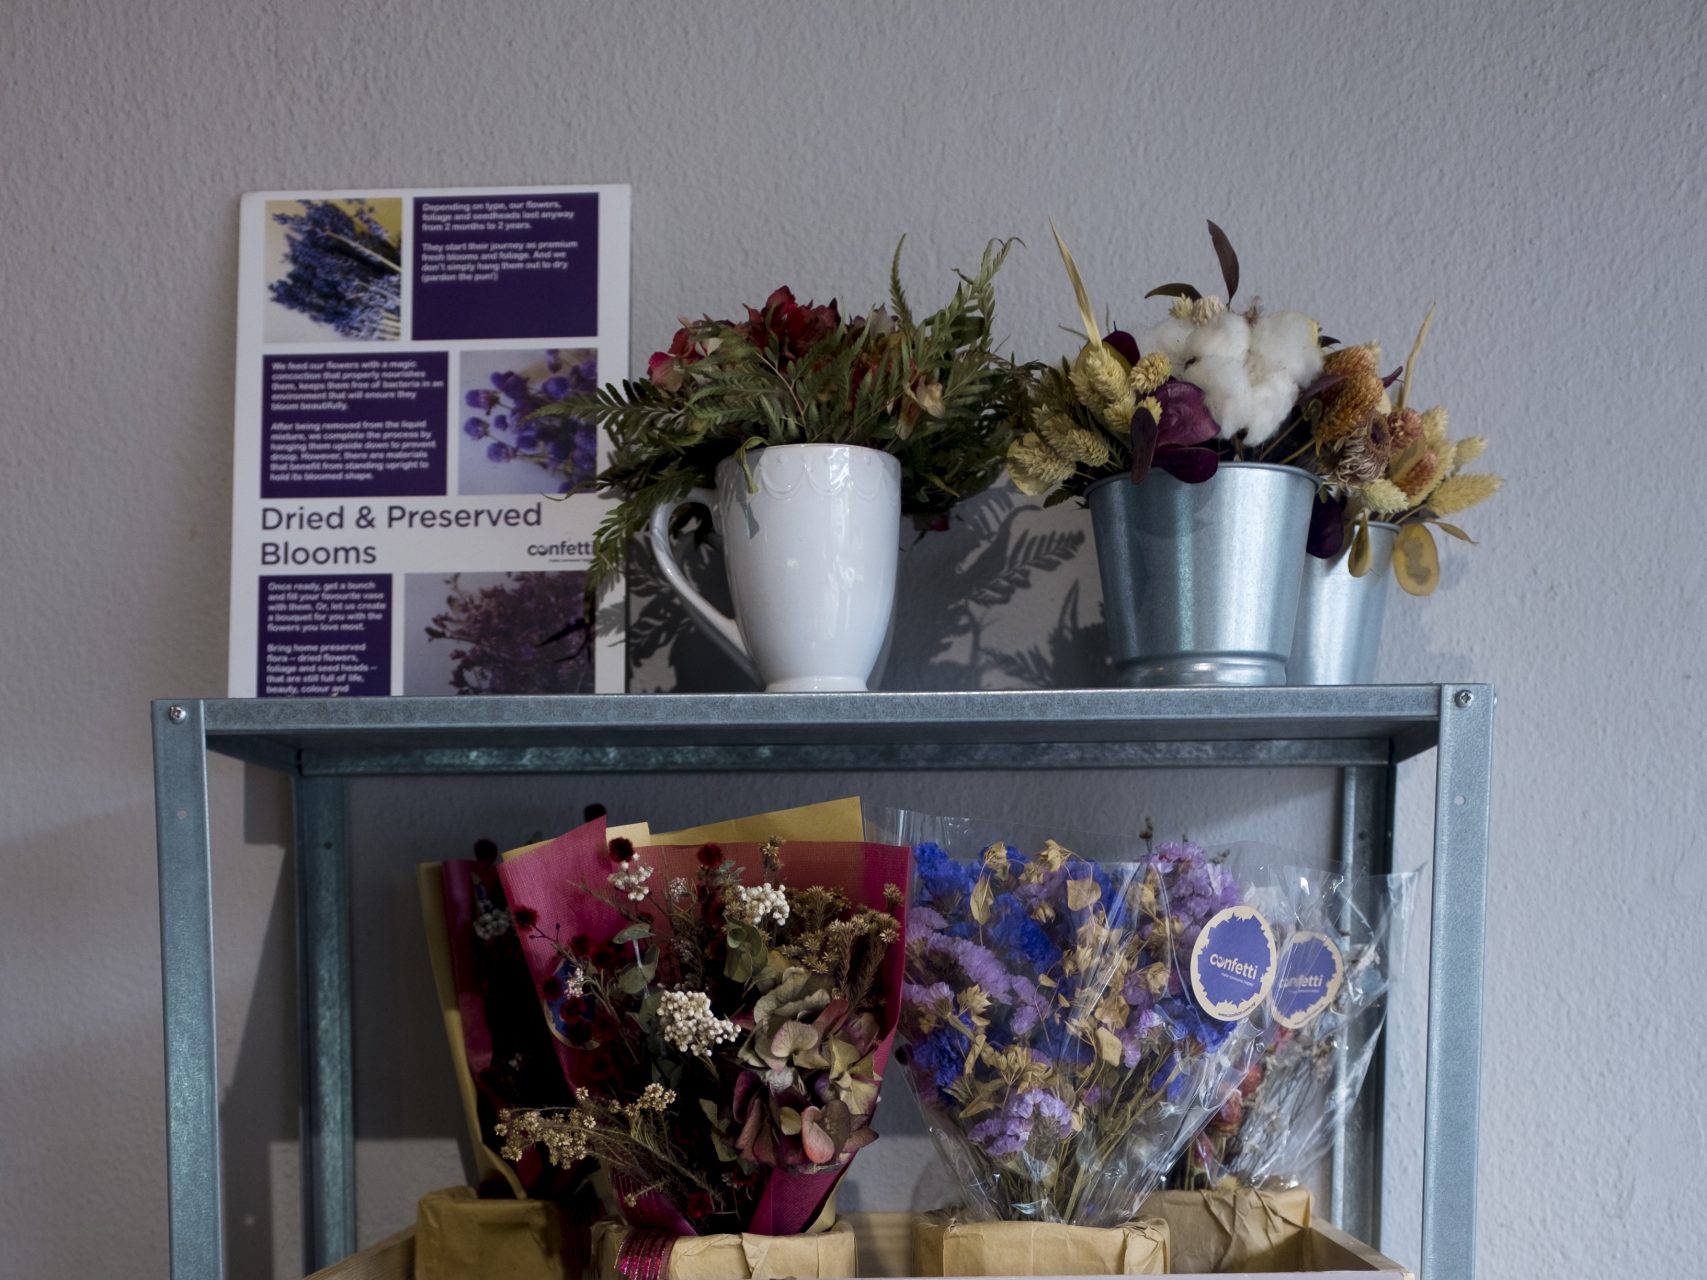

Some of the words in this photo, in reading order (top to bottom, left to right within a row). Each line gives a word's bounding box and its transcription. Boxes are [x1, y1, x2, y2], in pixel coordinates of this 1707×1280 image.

[261, 506, 344, 530] Dried
[356, 507, 376, 529] &
[387, 503, 541, 528] Preserved
[261, 542, 376, 566] Blooms
[527, 540, 594, 556] confett
[1210, 953, 1258, 979] confetti
